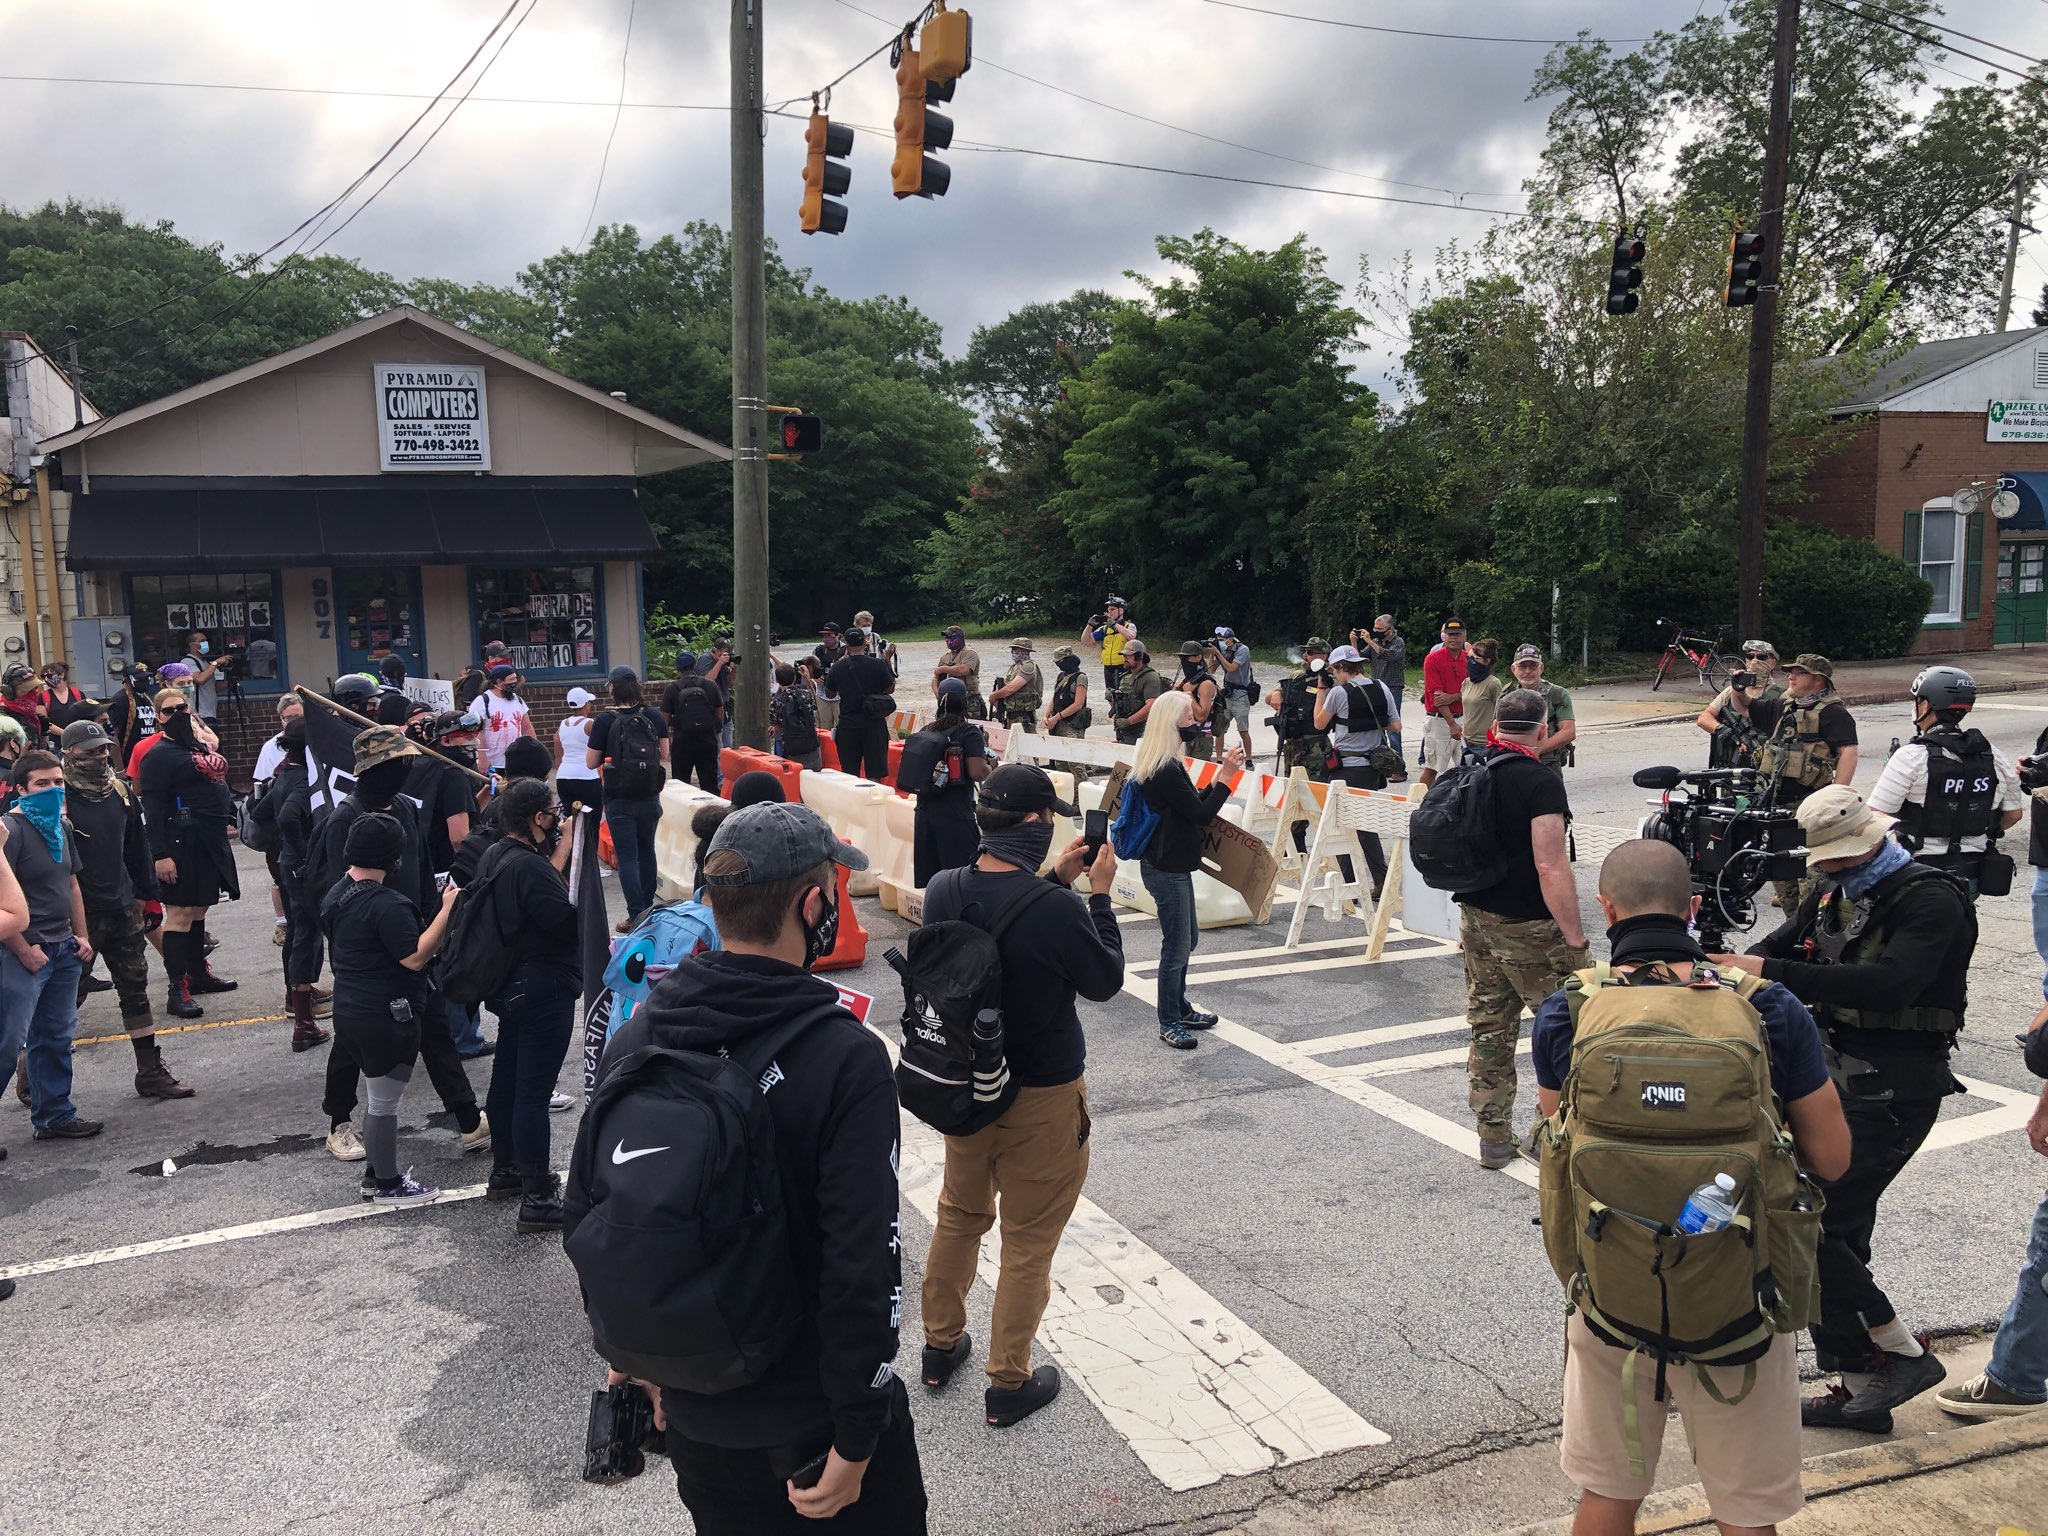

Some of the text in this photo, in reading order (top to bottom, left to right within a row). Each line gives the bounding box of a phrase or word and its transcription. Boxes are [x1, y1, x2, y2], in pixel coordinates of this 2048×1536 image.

[387, 373, 453, 386] PYRAMID
[388, 389, 477, 419] COMPUTERS
[2005, 402, 2037, 411] AZTEC
[2003, 418, 2013, 426] We
[2013, 418, 2029, 426] Make
[394, 439, 480, 451] 770-498-3422
[195, 603, 244, 628] FOR SALE
[576, 619, 593, 641] 2
[553, 644, 572, 667] 10
[427, 689, 451, 705] LIVES
[1944, 776, 1990, 793] PRSS
[915, 1027, 947, 1046] adidas
